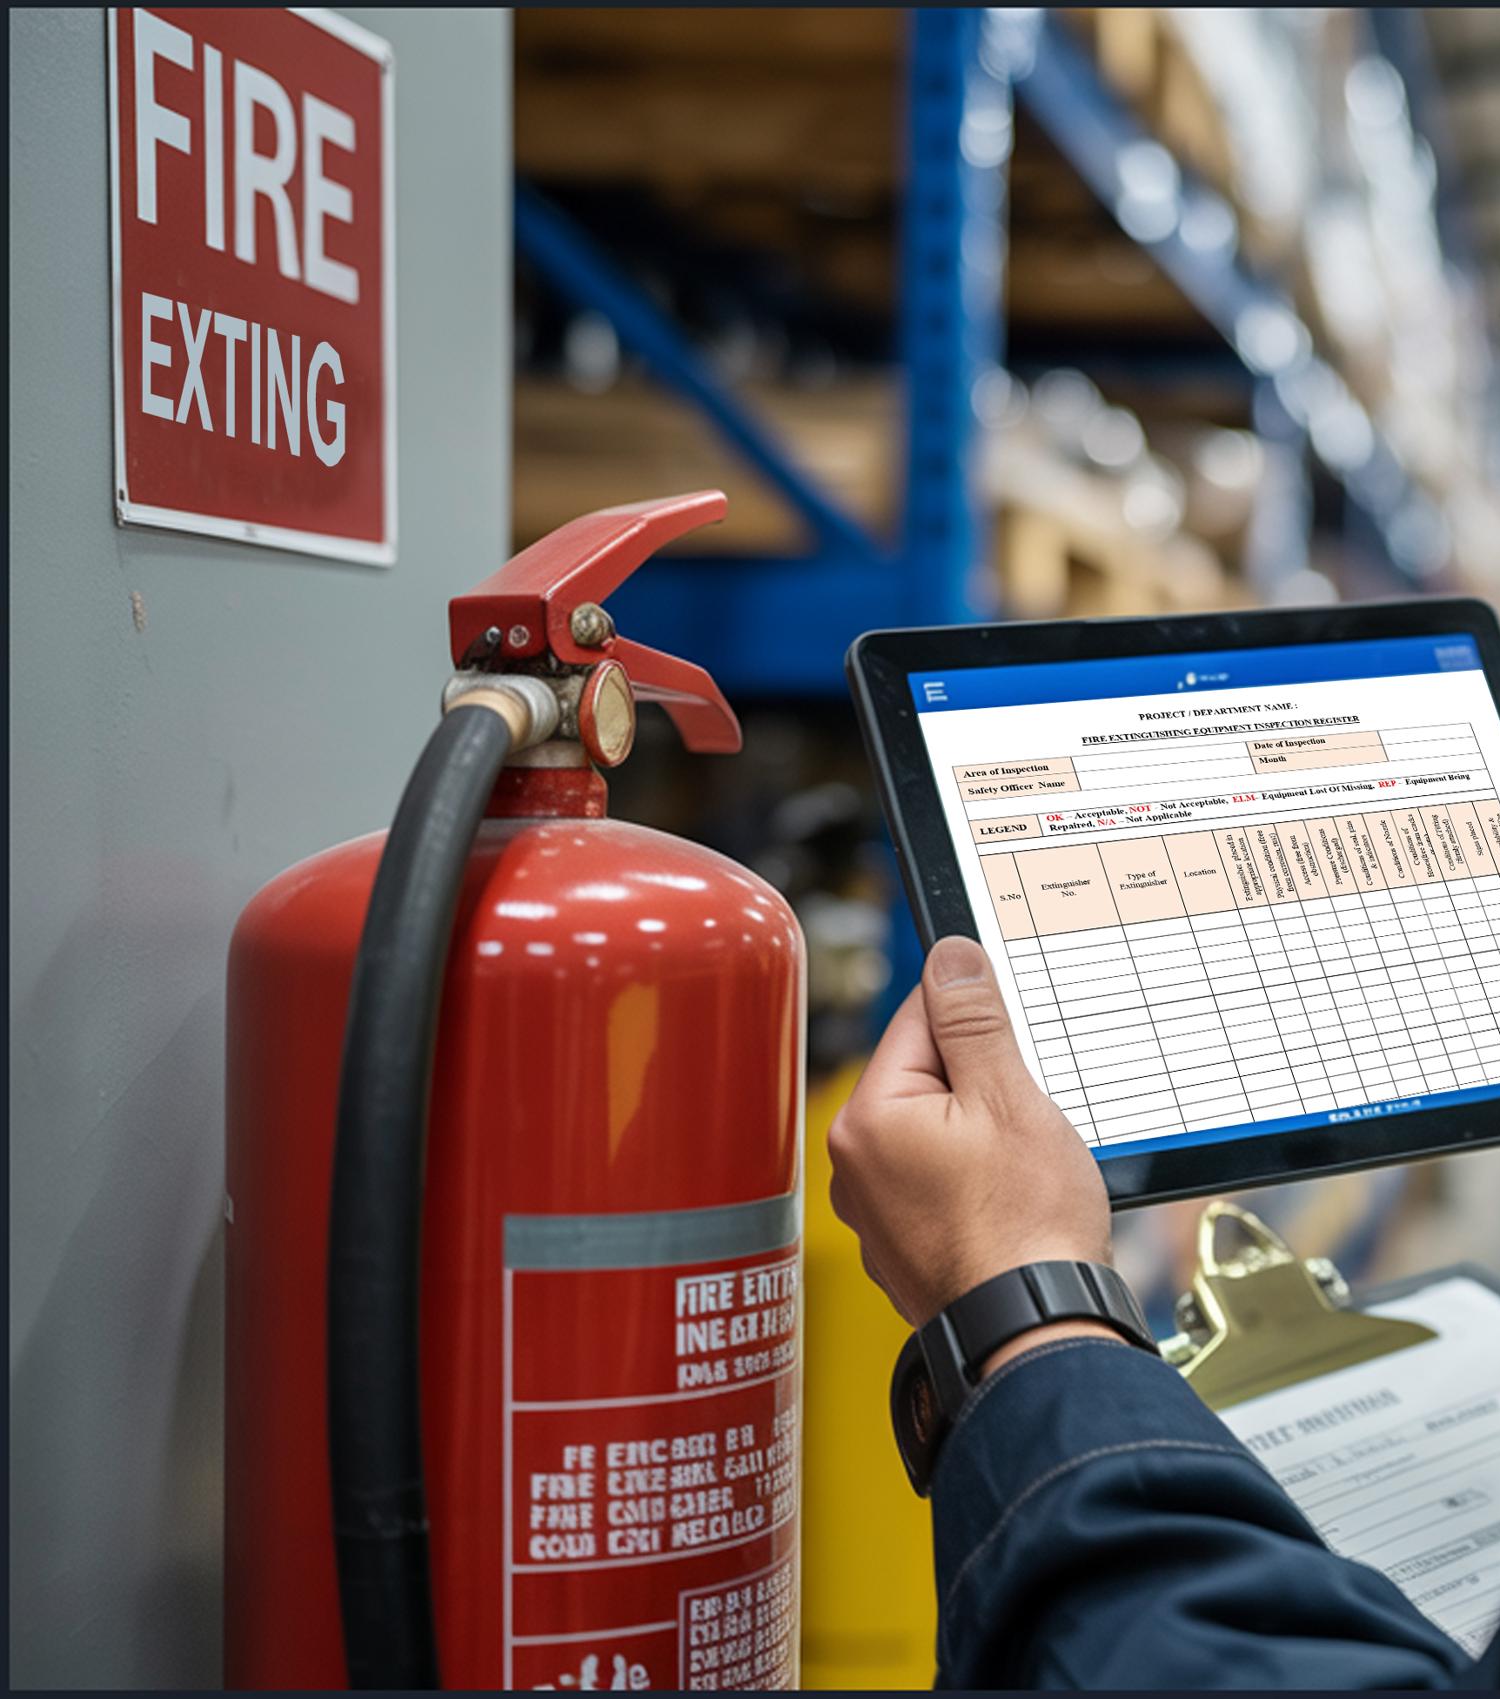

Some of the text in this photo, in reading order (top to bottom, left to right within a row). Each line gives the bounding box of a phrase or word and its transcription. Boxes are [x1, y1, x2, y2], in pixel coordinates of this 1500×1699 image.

[133, 8, 360, 305] FIRE
[141, 291, 346, 468] EXTING
[1138, 710, 1185, 721] PROJECT
[1193, 704, 1262, 717] DEPARTMENT
[1264, 702, 1293, 712] NAME
[1081, 715, 1360, 745] FIRE EXTINGUISHING EQUIPMENT INSPECTION REGISTER
[1254, 737, 1326, 751] Date of Inspection
[1258, 755, 1287, 765] Month
[963, 763, 1050, 779] Area of Inspection
[968, 780, 1066, 797] Safety Officer Name
[1046, 813, 1064, 823] OK
[1074, 807, 1128, 821] Acceptable,
[1129, 804, 1153, 814] NOT
[1160, 801, 1177, 811] Not
[1179, 798, 1229, 811] Acceptable,
[1261, 788, 1308, 801] Equipment
[1309, 787, 1328, 796] Lost
[1328, 785, 1341, 793] Of
[1341, 782, 1376, 794] Missing,
[1378, 780, 1397, 789] REP
[1405, 775, 1448, 786] Equipment
[1448, 772, 1471, 783] Being
[1049, 820, 1096, 833] Repaired,
[1097, 818, 1116, 827] N/A
[1126, 815, 1144, 824] Not
[1145, 810, 1193, 823] Applicable
[980, 823, 1028, 836] LEGEND
[1127, 870, 1156, 882] Type of
[1183, 868, 1217, 879] Location
[1041, 878, 1091, 891] Extinguisher
[1119, 878, 1168, 891] Extinguisher
[999, 893, 1022, 902] S.No
[1061, 889, 1077, 899] No.
